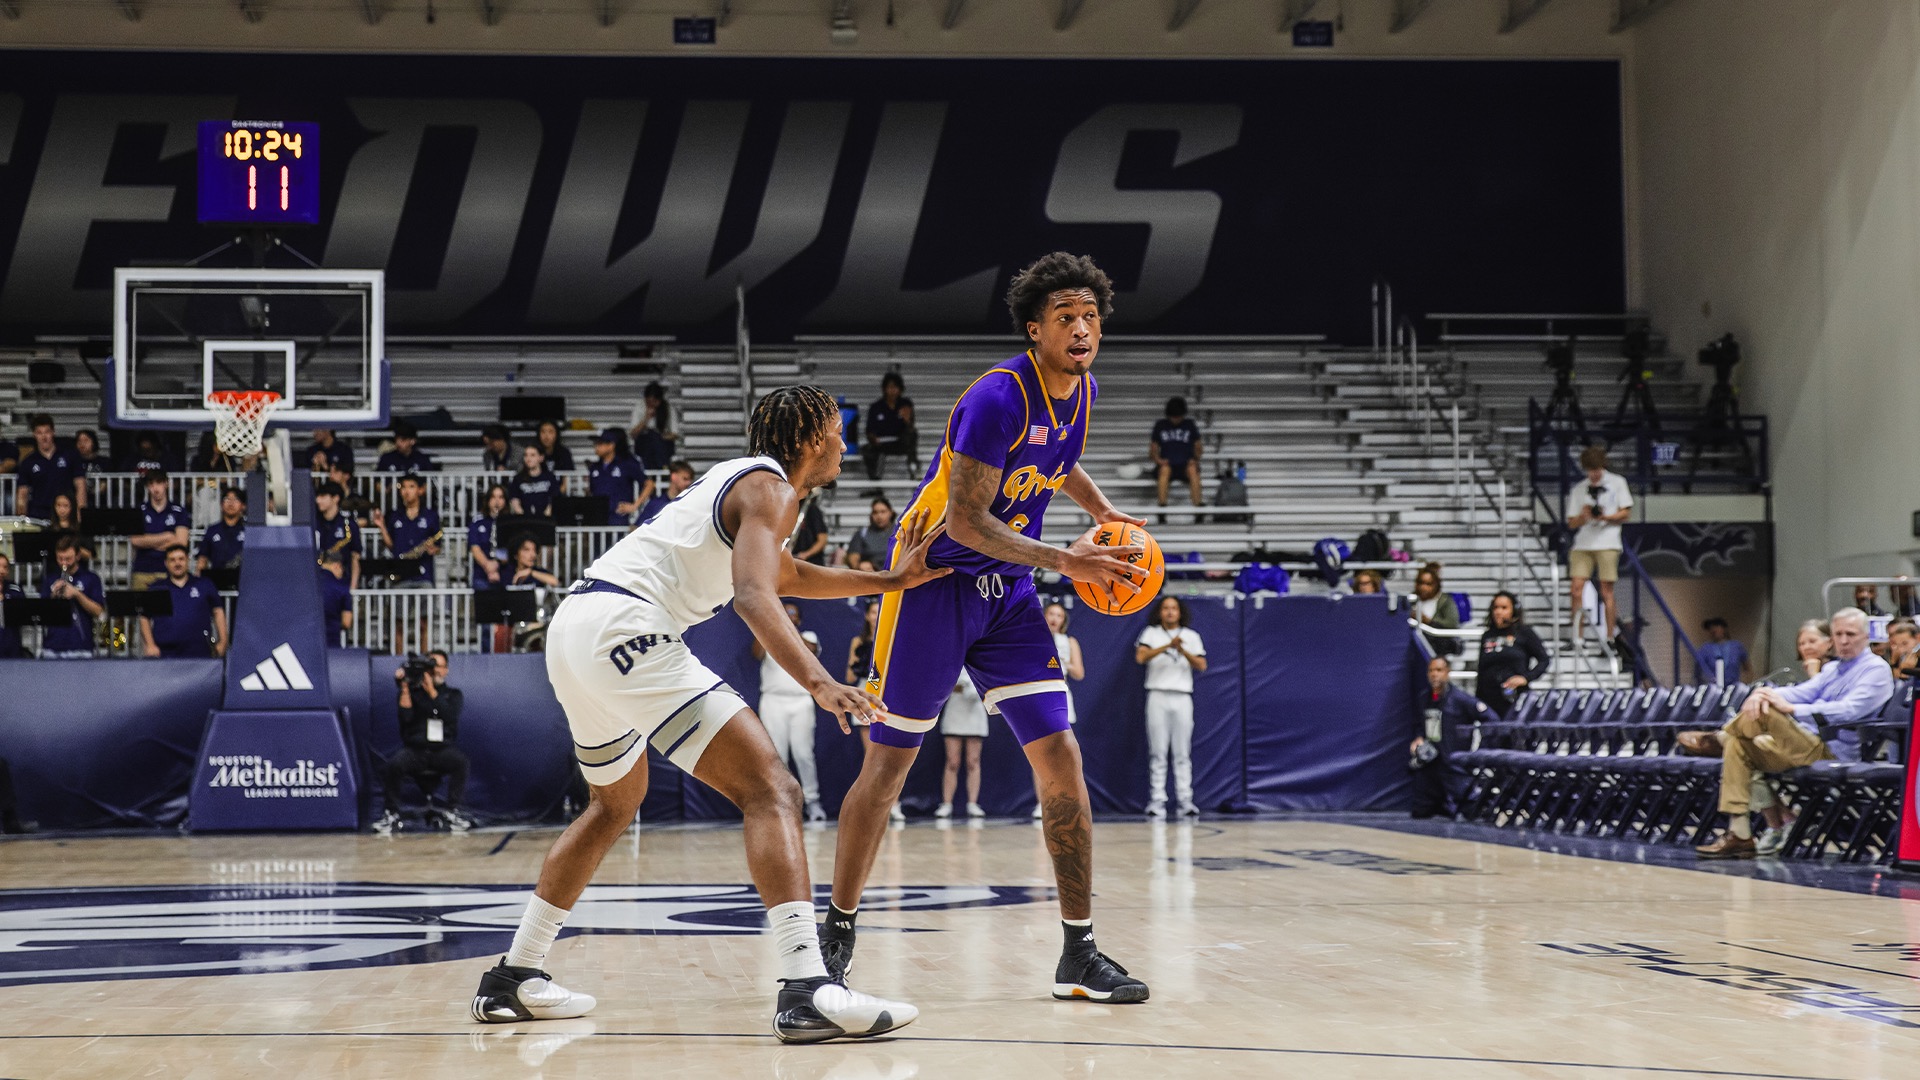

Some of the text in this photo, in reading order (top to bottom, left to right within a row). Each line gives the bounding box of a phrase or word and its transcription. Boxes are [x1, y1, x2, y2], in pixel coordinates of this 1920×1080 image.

[224, 129, 302, 161] 10:24
[248, 165, 289, 211] 11
[312, 98, 1243, 323] OWLS
[208, 755, 262, 766] HOUSTON
[208, 759, 340, 788] Methodist
[244, 788, 339, 798] LEADING MEDICINE
